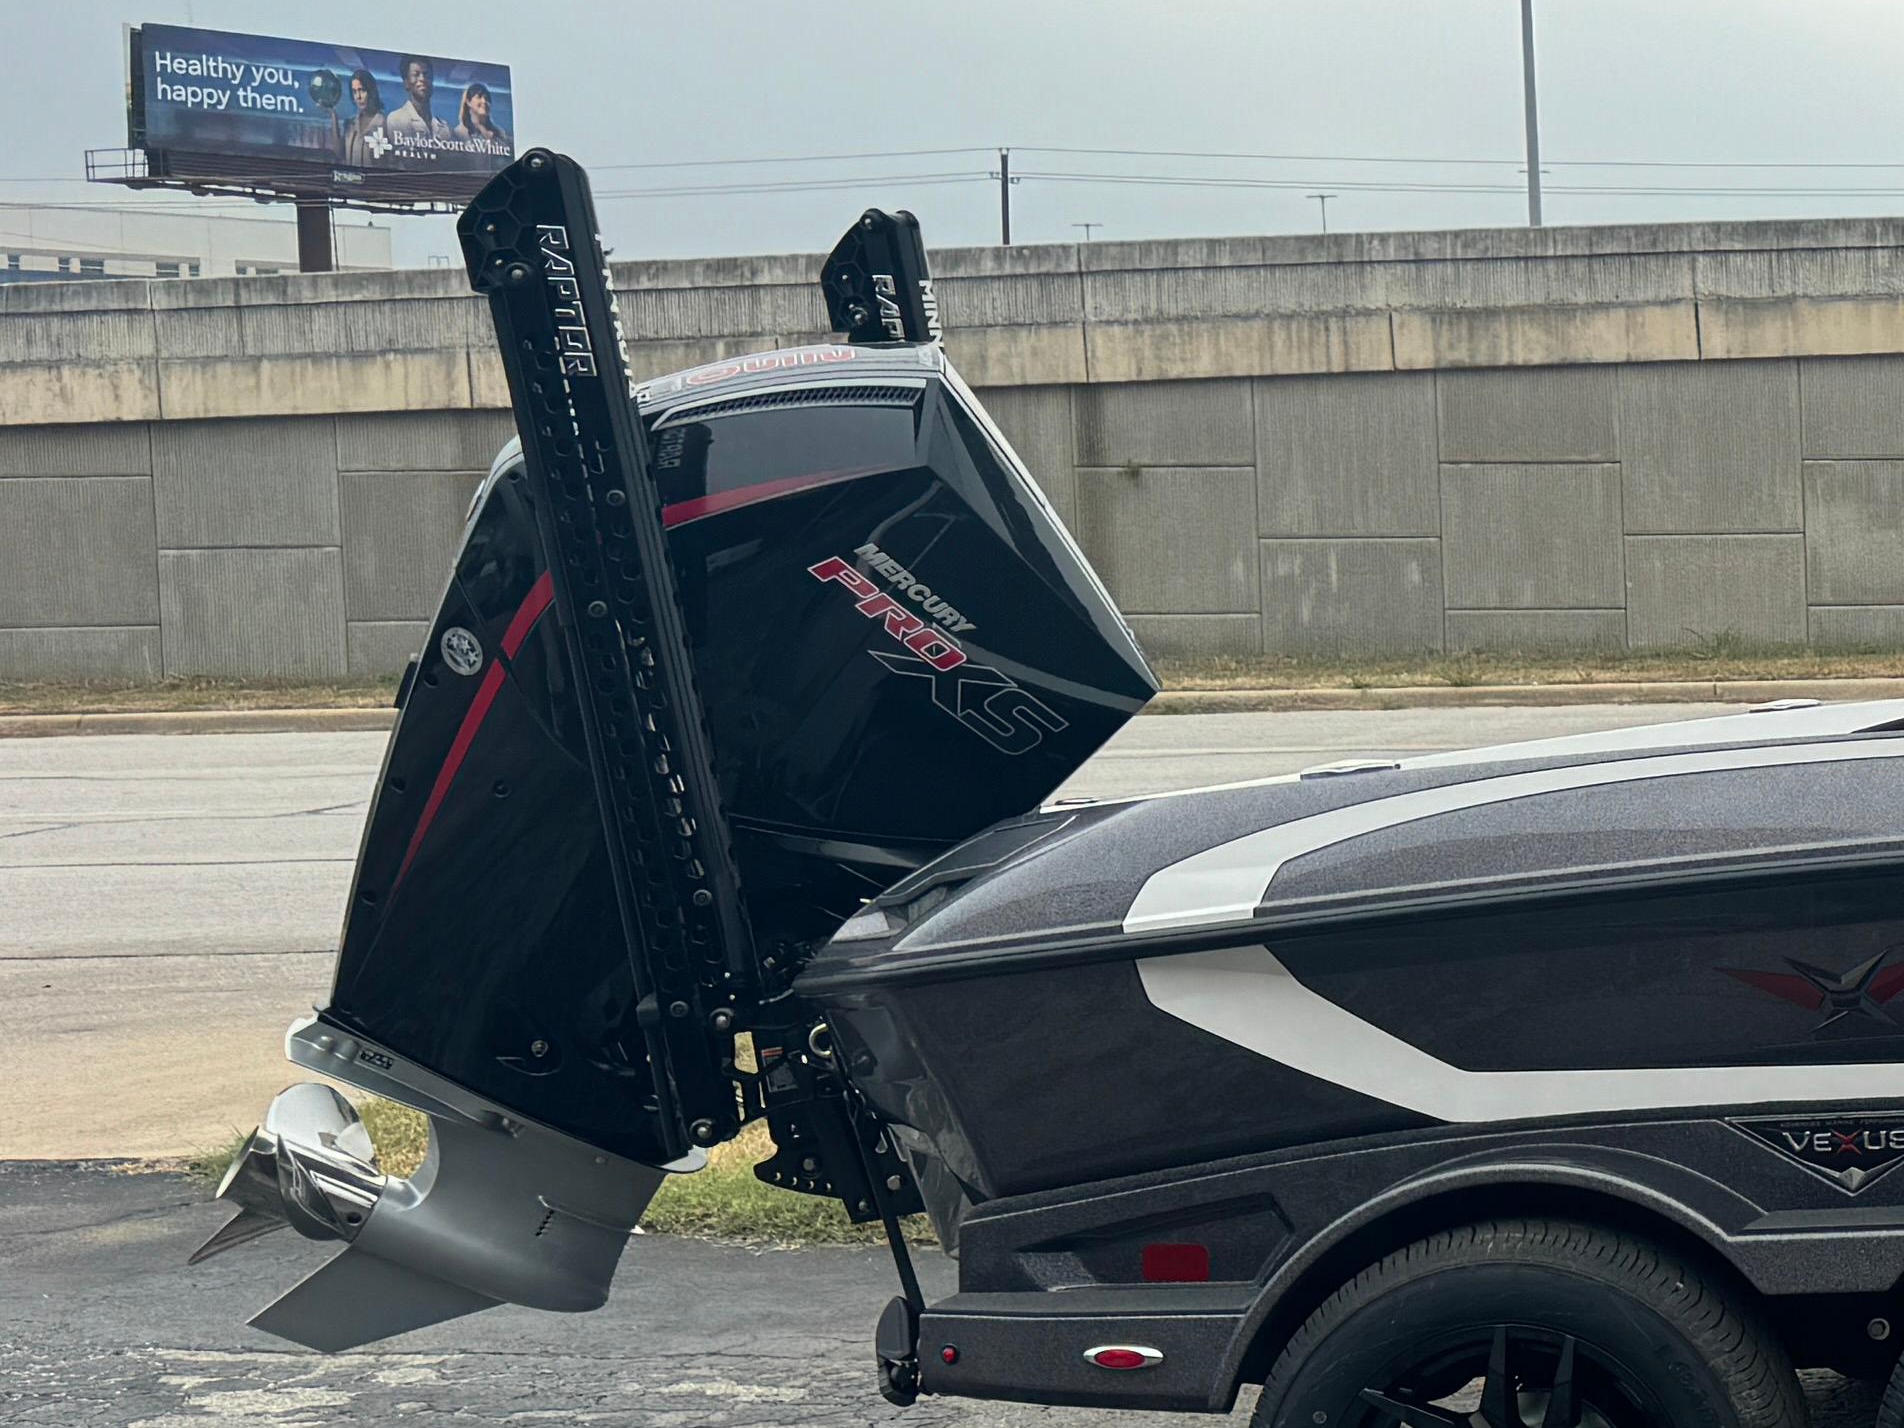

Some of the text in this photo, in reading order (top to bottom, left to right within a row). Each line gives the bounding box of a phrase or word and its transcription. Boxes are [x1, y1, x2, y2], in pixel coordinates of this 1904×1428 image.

[155, 51, 300, 89] Healthy you,
[157, 77, 304, 113] happy them.
[536, 224, 597, 377] RAPTOR
[807, 556, 967, 671] PRO
[853, 543, 977, 632] MERCURY
[867, 650, 1070, 755] XS
